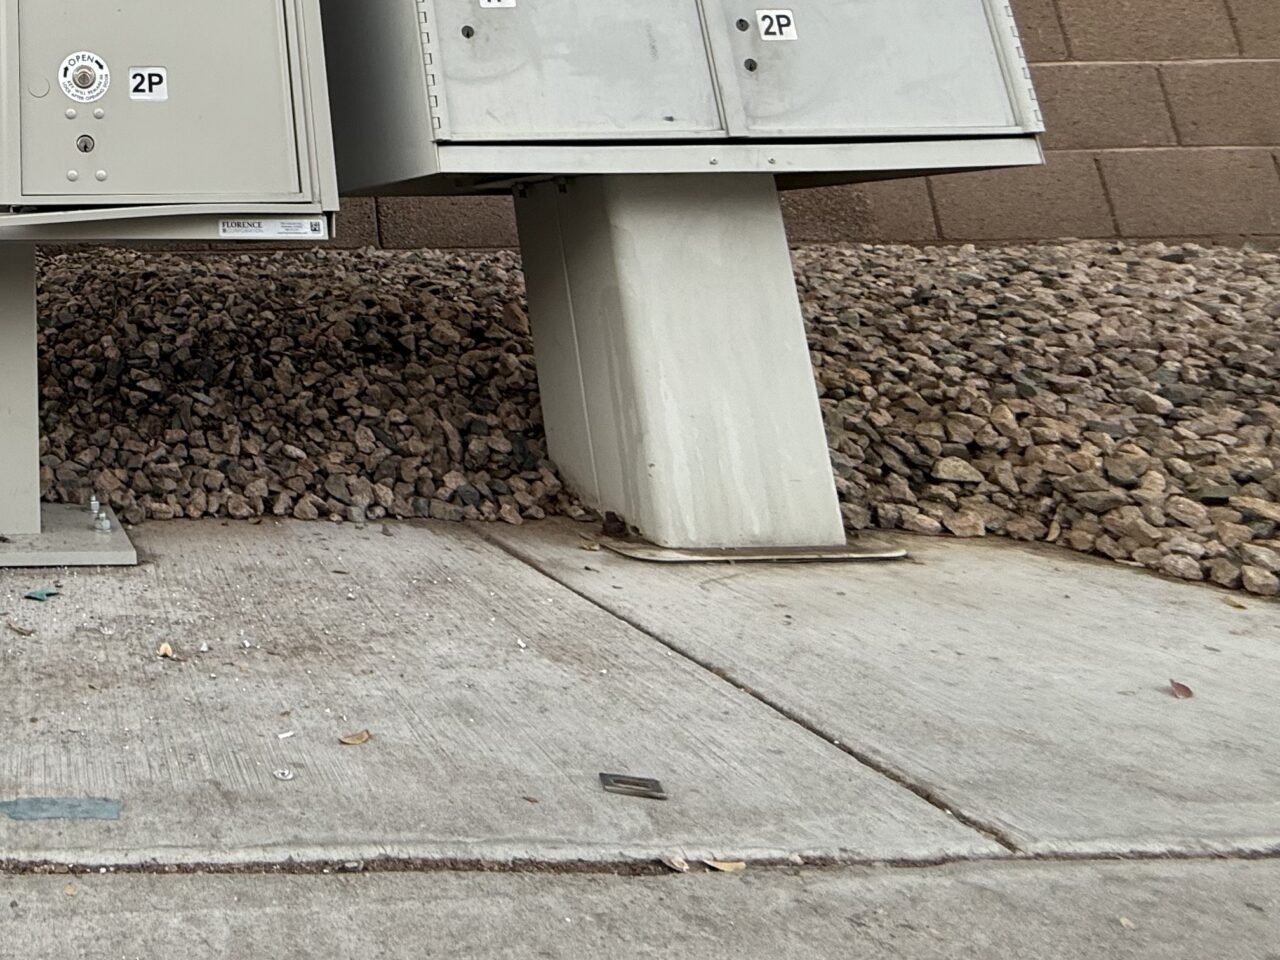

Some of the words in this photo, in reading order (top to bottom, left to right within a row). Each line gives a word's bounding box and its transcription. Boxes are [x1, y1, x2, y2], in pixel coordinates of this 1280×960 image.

[761, 14, 792, 36] 2P
[68, 54, 95, 67] OPEN
[131, 72, 164, 93] 2P
[222, 221, 263, 229] FLORENCE
